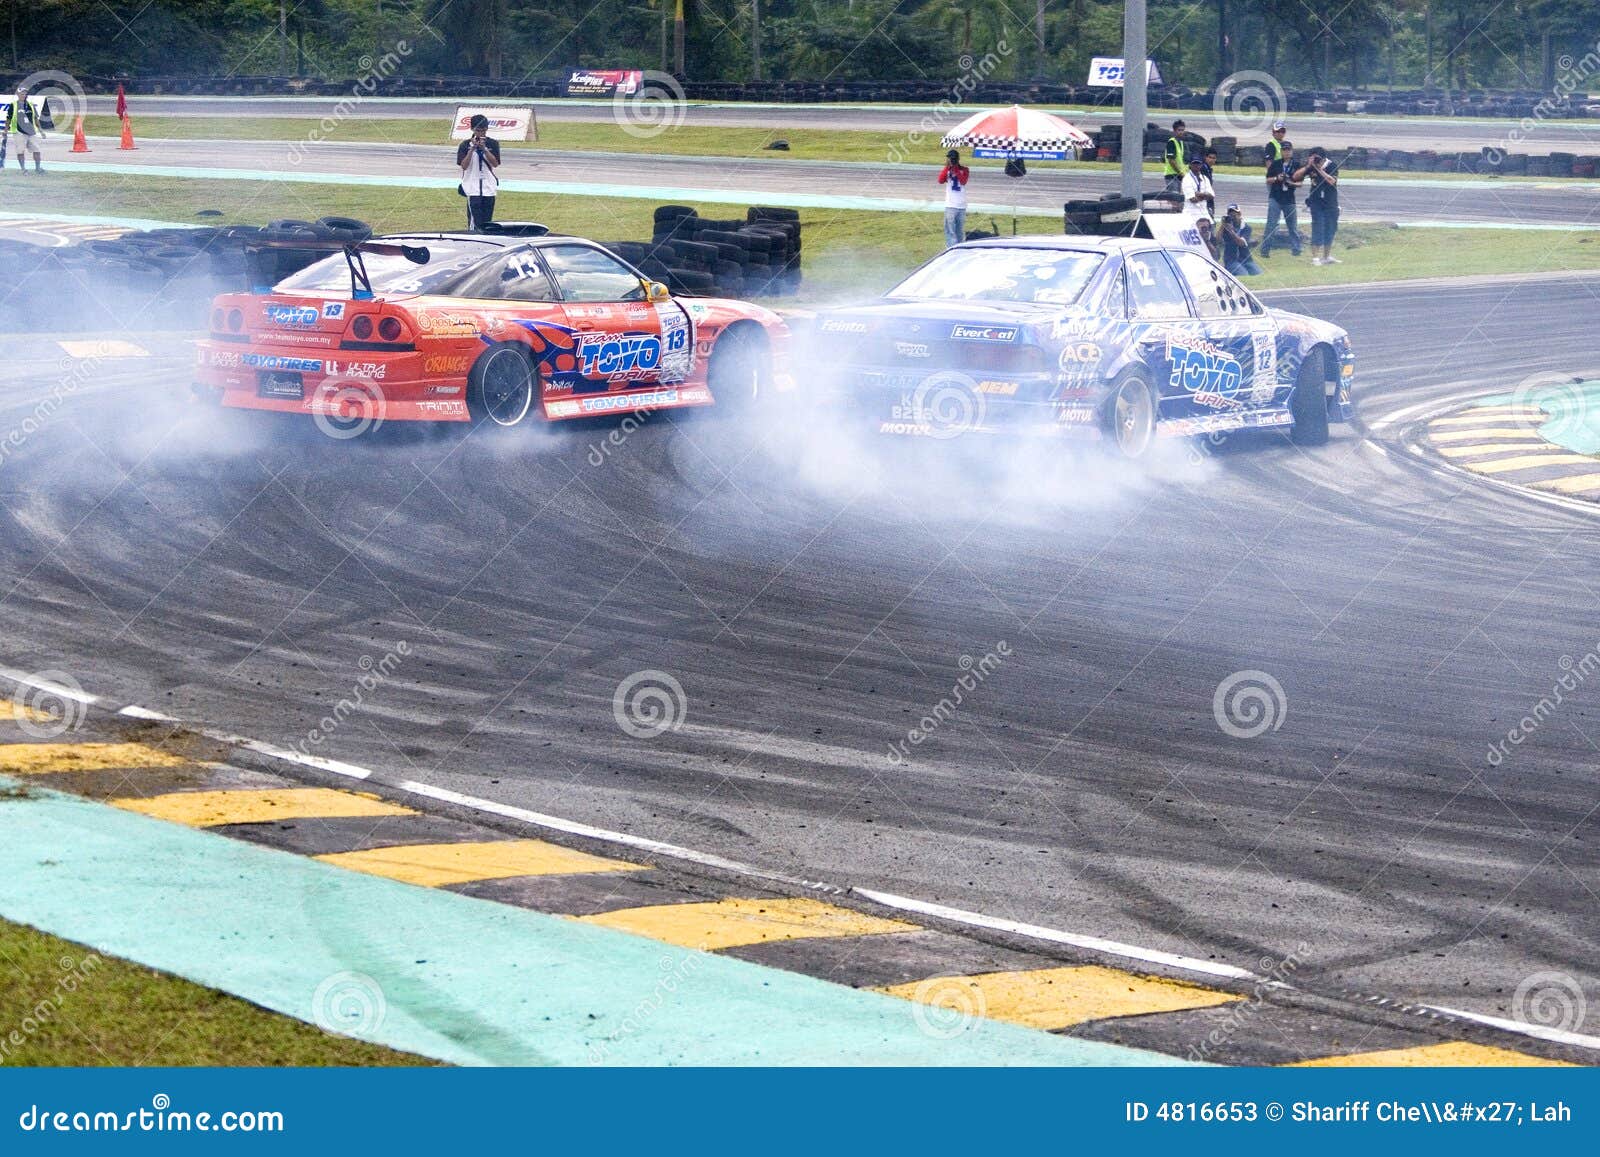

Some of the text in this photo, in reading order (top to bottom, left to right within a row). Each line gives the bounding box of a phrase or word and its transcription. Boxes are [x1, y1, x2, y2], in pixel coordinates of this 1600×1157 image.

[508, 252, 541, 280] 13
[263, 304, 319, 325] TOYO
[324, 304, 342, 316] 13
[663, 315, 681, 327] TOYO
[572, 331, 626, 358] Team
[667, 329, 686, 350] 13
[954, 327, 1014, 341] EverCoat
[580, 337, 662, 376] TOYO
[347, 362, 386, 373] ULTRA
[1168, 345, 1242, 400] TOYO
[1058, 408, 1094, 422] MOTUL
